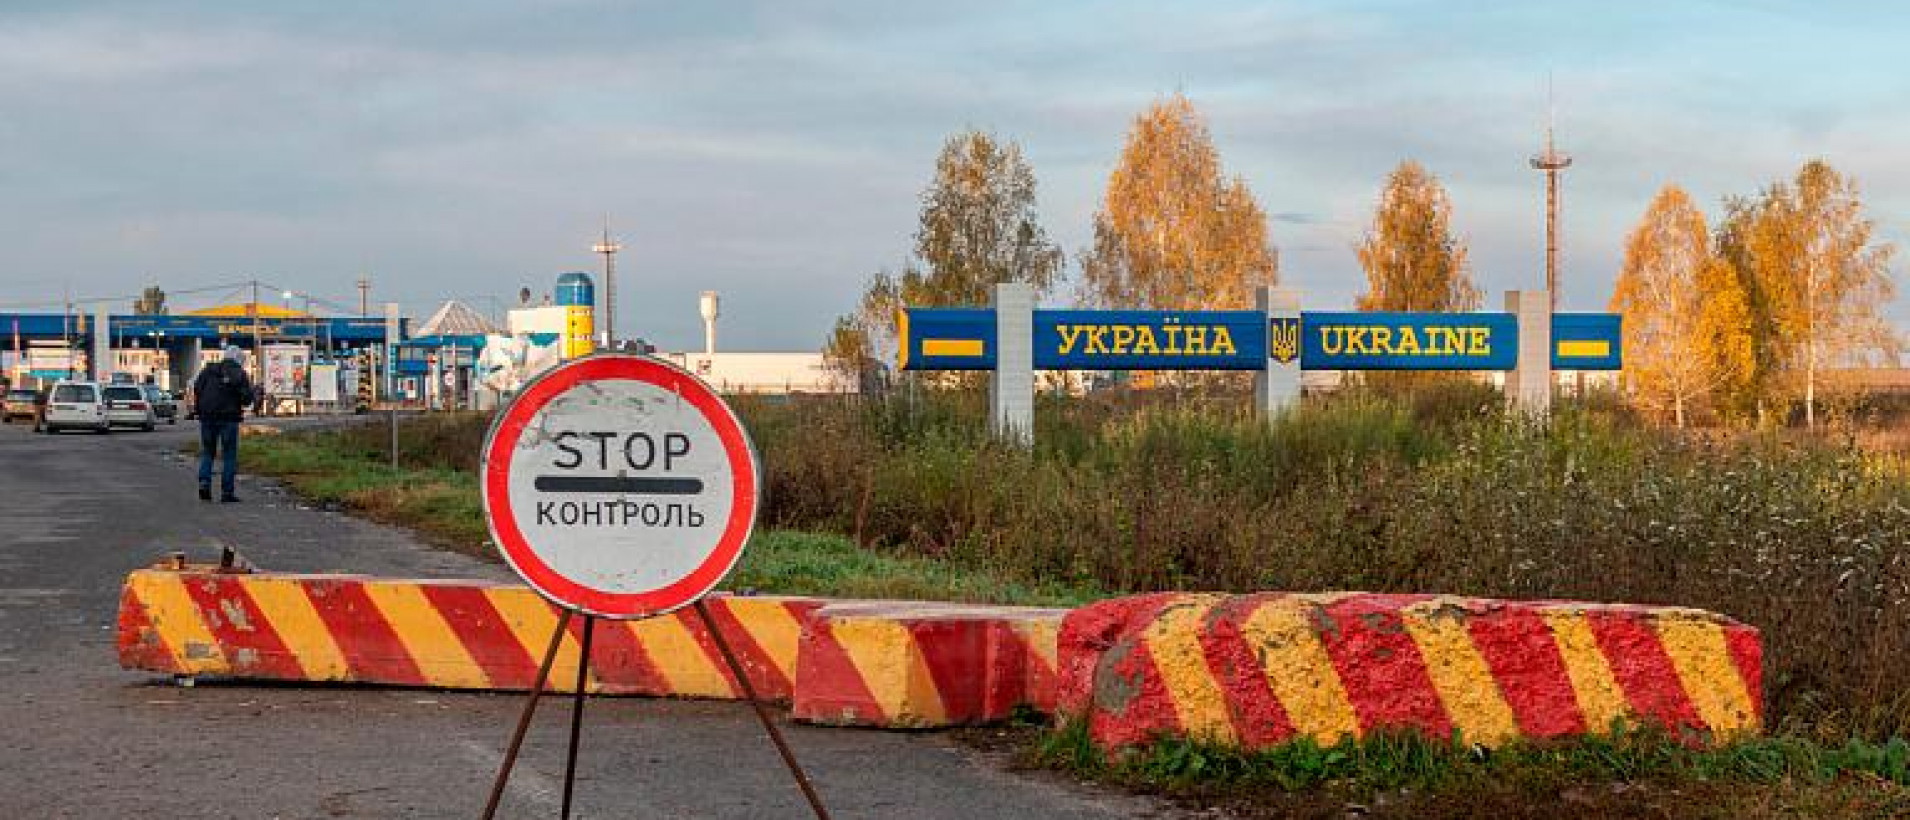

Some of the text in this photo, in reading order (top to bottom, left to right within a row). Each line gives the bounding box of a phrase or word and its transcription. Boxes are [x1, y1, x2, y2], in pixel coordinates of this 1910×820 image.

[1056, 317, 1236, 355] УКРАЇНА
[1320, 326, 1491, 355] UKRAINE
[553, 431, 691, 470] STOP
[536, 501, 705, 528] КОНТРОЛЬ
